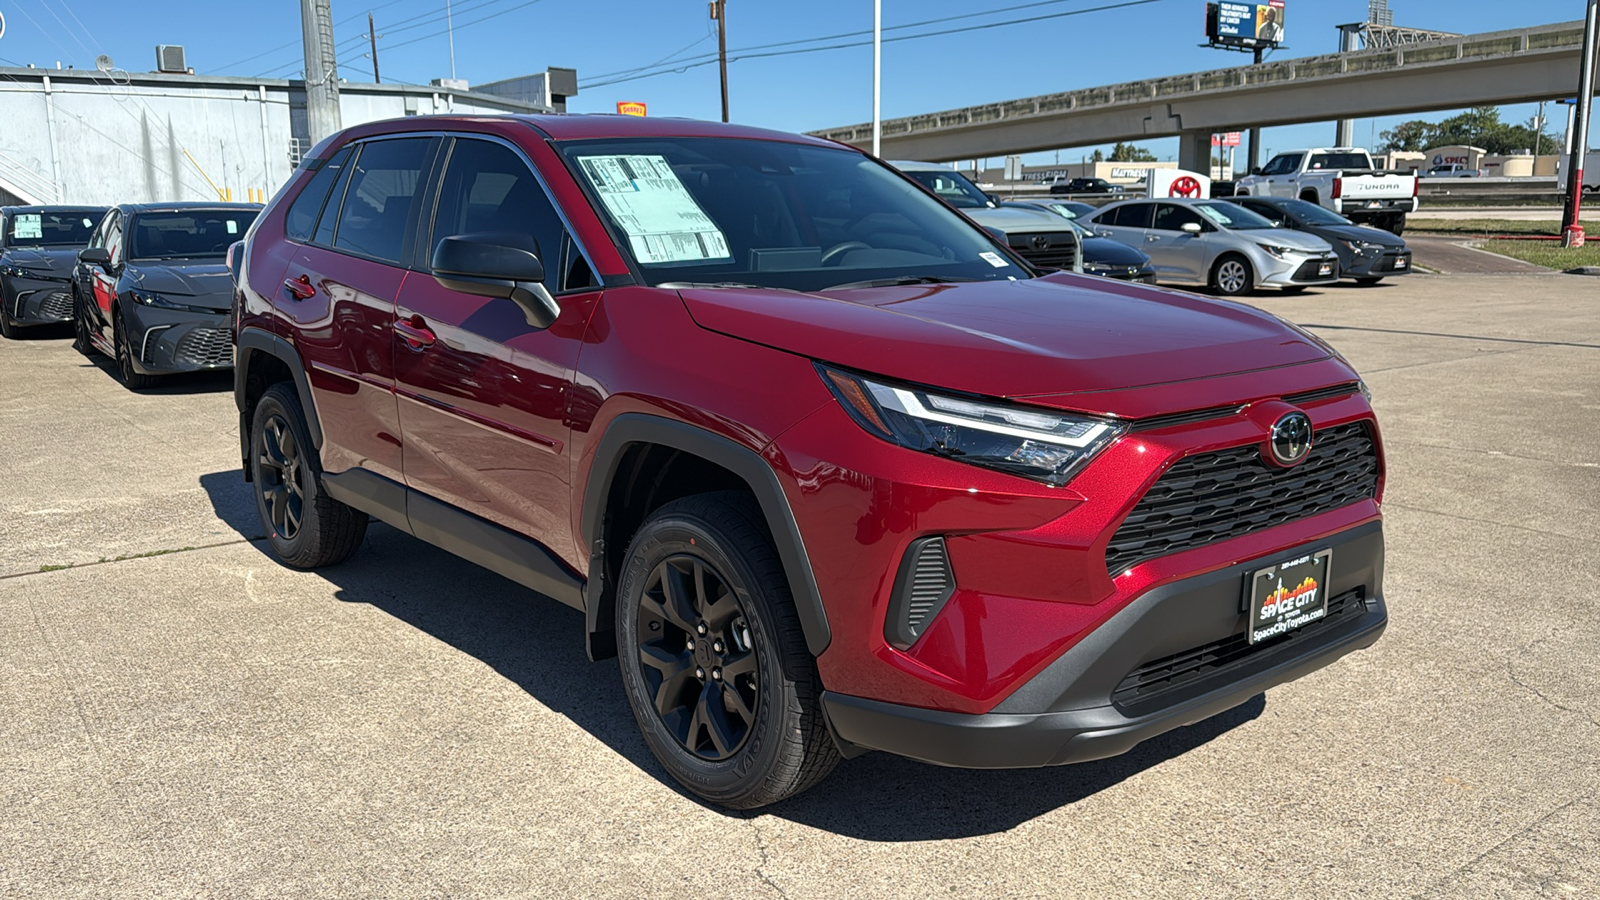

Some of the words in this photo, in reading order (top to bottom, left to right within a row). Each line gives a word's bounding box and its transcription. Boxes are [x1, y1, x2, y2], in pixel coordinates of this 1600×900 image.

[1260, 597, 1295, 620] SPACE
[1296, 588, 1318, 607] CITY
[1253, 608, 1324, 642] SpaceCityToyota.com
